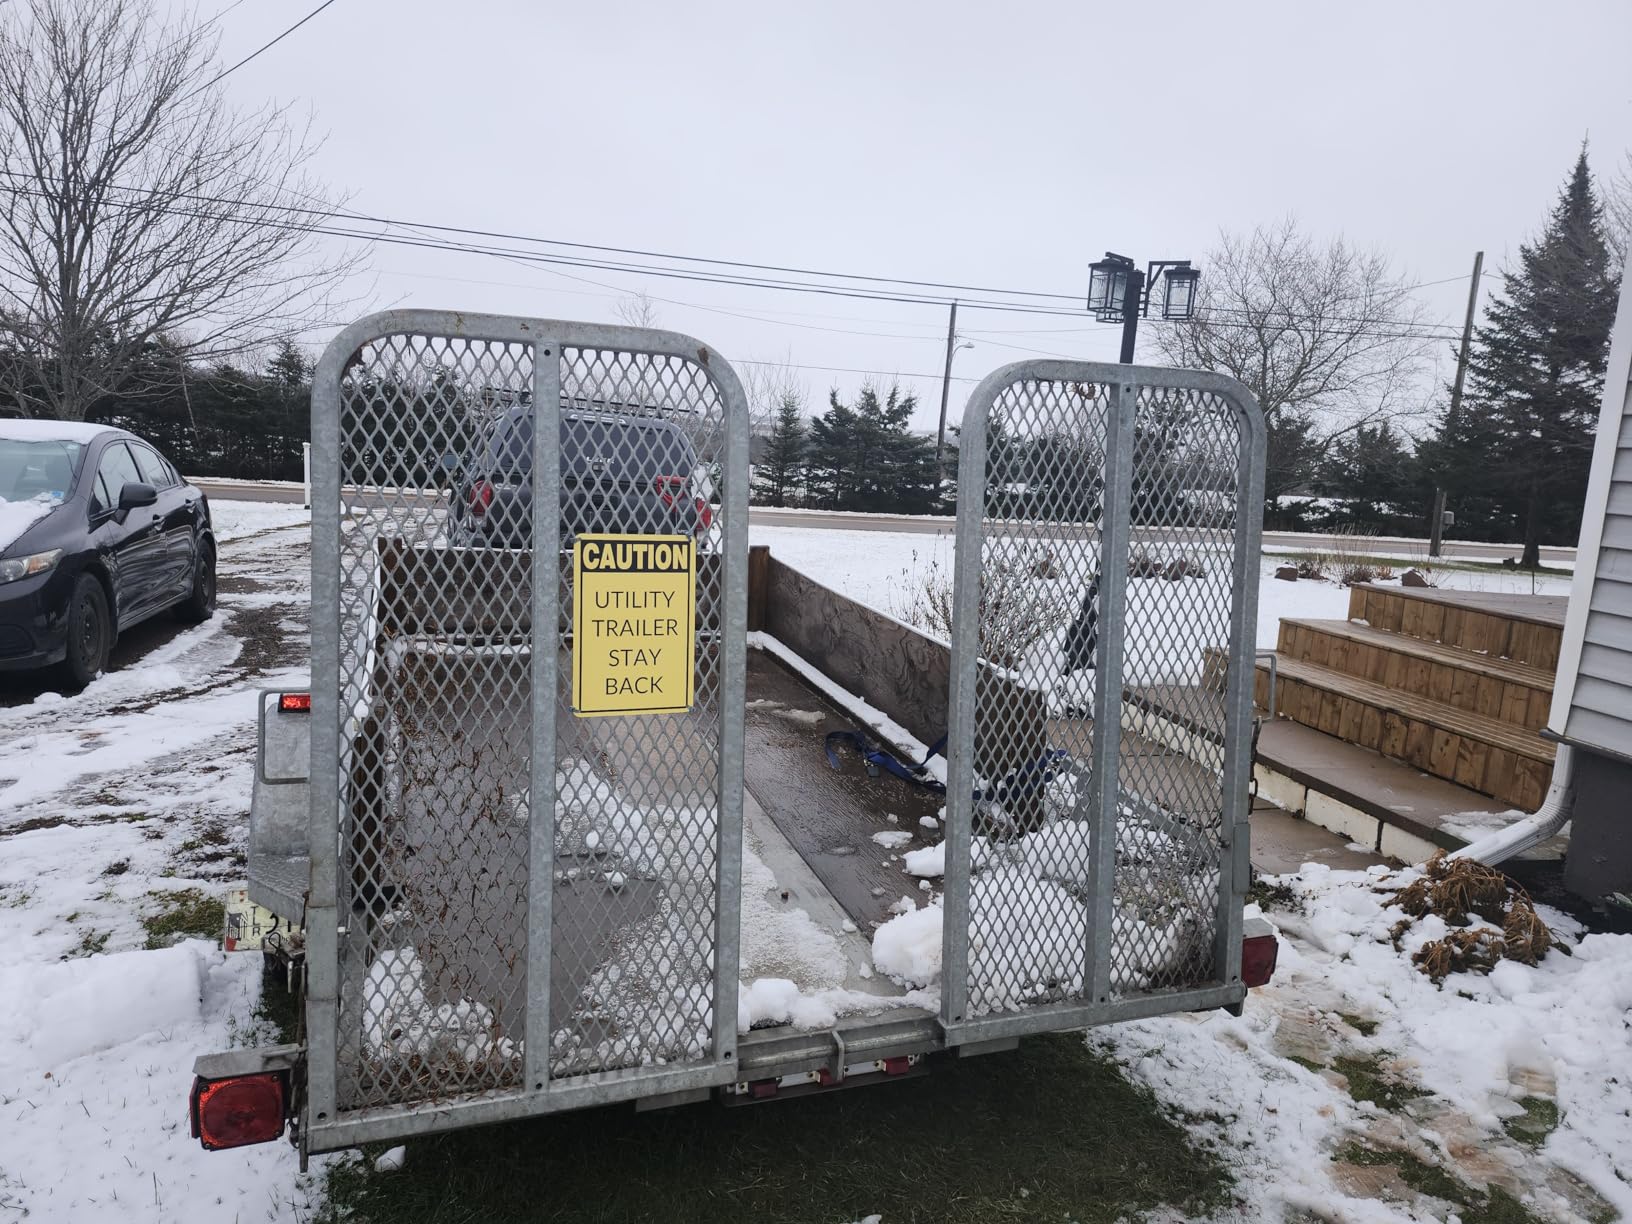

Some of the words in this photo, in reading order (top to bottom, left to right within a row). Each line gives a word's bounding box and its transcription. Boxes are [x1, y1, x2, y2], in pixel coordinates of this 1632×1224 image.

[582, 543, 688, 570] CAUTION
[596, 592, 674, 608] UTILITY
[592, 619, 678, 636] TRAILER
[609, 649, 661, 666] STAY
[606, 677, 662, 695] BACK
